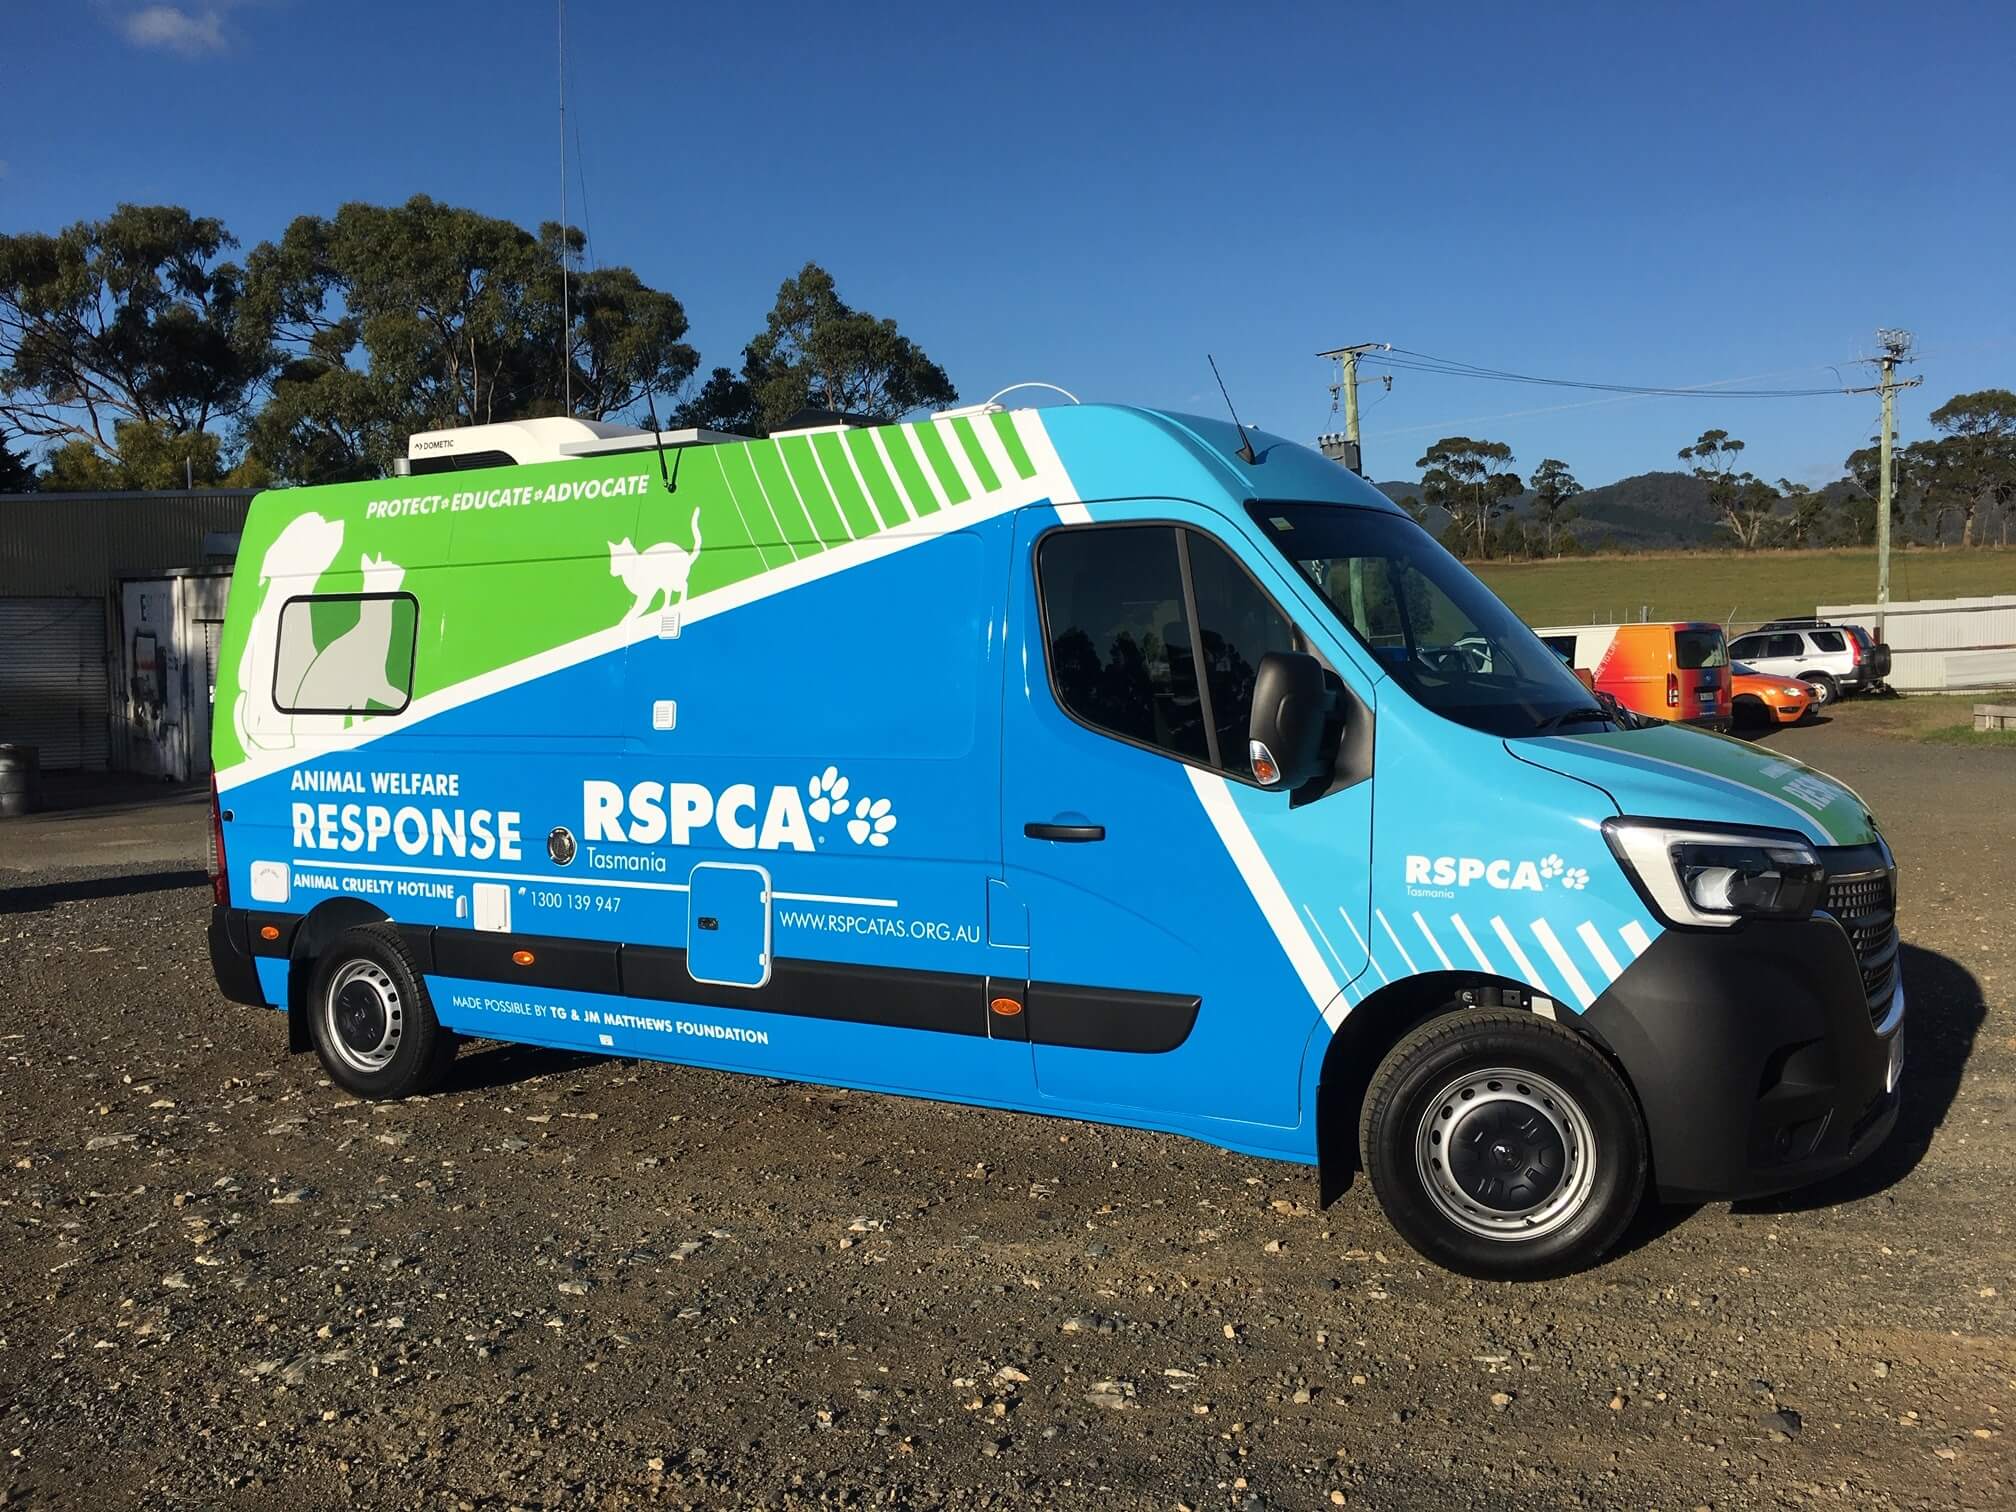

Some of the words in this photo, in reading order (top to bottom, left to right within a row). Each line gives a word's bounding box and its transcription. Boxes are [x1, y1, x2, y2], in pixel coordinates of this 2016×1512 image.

[424, 440, 454, 450] DOMETIC
[365, 496, 442, 519] PROTECT
[450, 487, 533, 512] EDUCATE
[542, 474, 650, 504] ADVOCATE
[291, 770, 366, 794] ANIMAL
[371, 774, 459, 797] WELFARE
[583, 780, 816, 852] RSPCA
[292, 802, 522, 862] RESPONSE
[587, 847, 667, 873] Tasmania
[1405, 855, 1543, 892] RSPCA
[293, 873, 340, 890] ANIMAL
[342, 877, 395, 896] CRUELTY
[397, 880, 455, 900] HOTLINE
[1406, 885, 1455, 899] Tasmania
[531, 891, 562, 909] 1300
[567, 894, 591, 911] 139
[596, 896, 621, 913] 947
[779, 911, 980, 943] WWW.RSPCATAS.ORG.AU
[452, 995, 482, 1011] MADE
[484, 998, 531, 1016] POSSIBLE
[534, 1005, 547, 1018] BY
[550, 1006, 567, 1020] TG
[571, 1009, 580, 1022] &
[583, 1010, 600, 1024] JM
[603, 1013, 673, 1034] MATTHEWS
[676, 1021, 769, 1045] FOUNDATION
